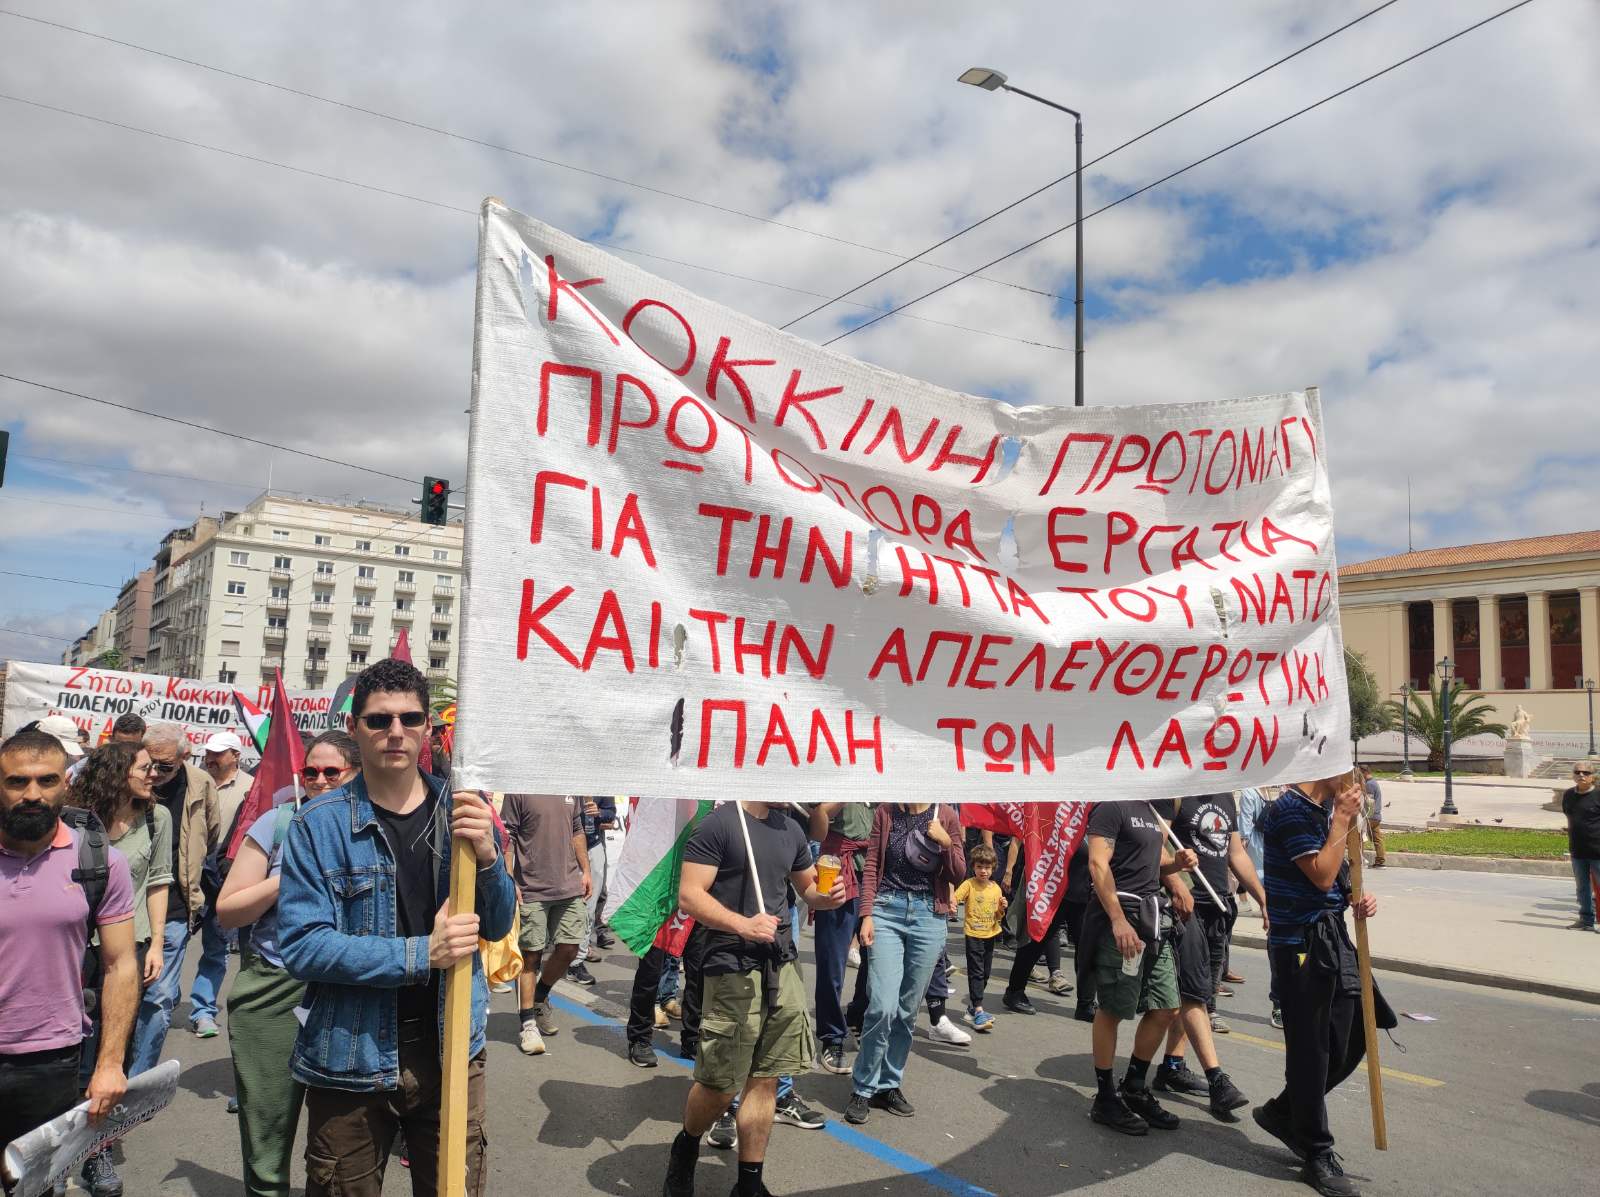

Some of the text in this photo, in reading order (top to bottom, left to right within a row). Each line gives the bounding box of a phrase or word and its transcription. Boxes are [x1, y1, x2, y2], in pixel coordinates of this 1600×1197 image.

[545, 256, 1000, 484] ΚΟΚΚΙΝΗ
[530, 470, 1332, 630] ΓΙΑ ΤΗΝ ΗΤΤΑ ΤΟΥ ΝΑΤΟ
[1047, 506, 1318, 576] ΕΡΓΑΤΙΑ
[516, 578, 662, 673] ΚΑΙ
[688, 608, 835, 679] ΤΗΝ
[697, 699, 1279, 775] ΠΑΛΗ ΤΩΝ ΛΑΩΝ
